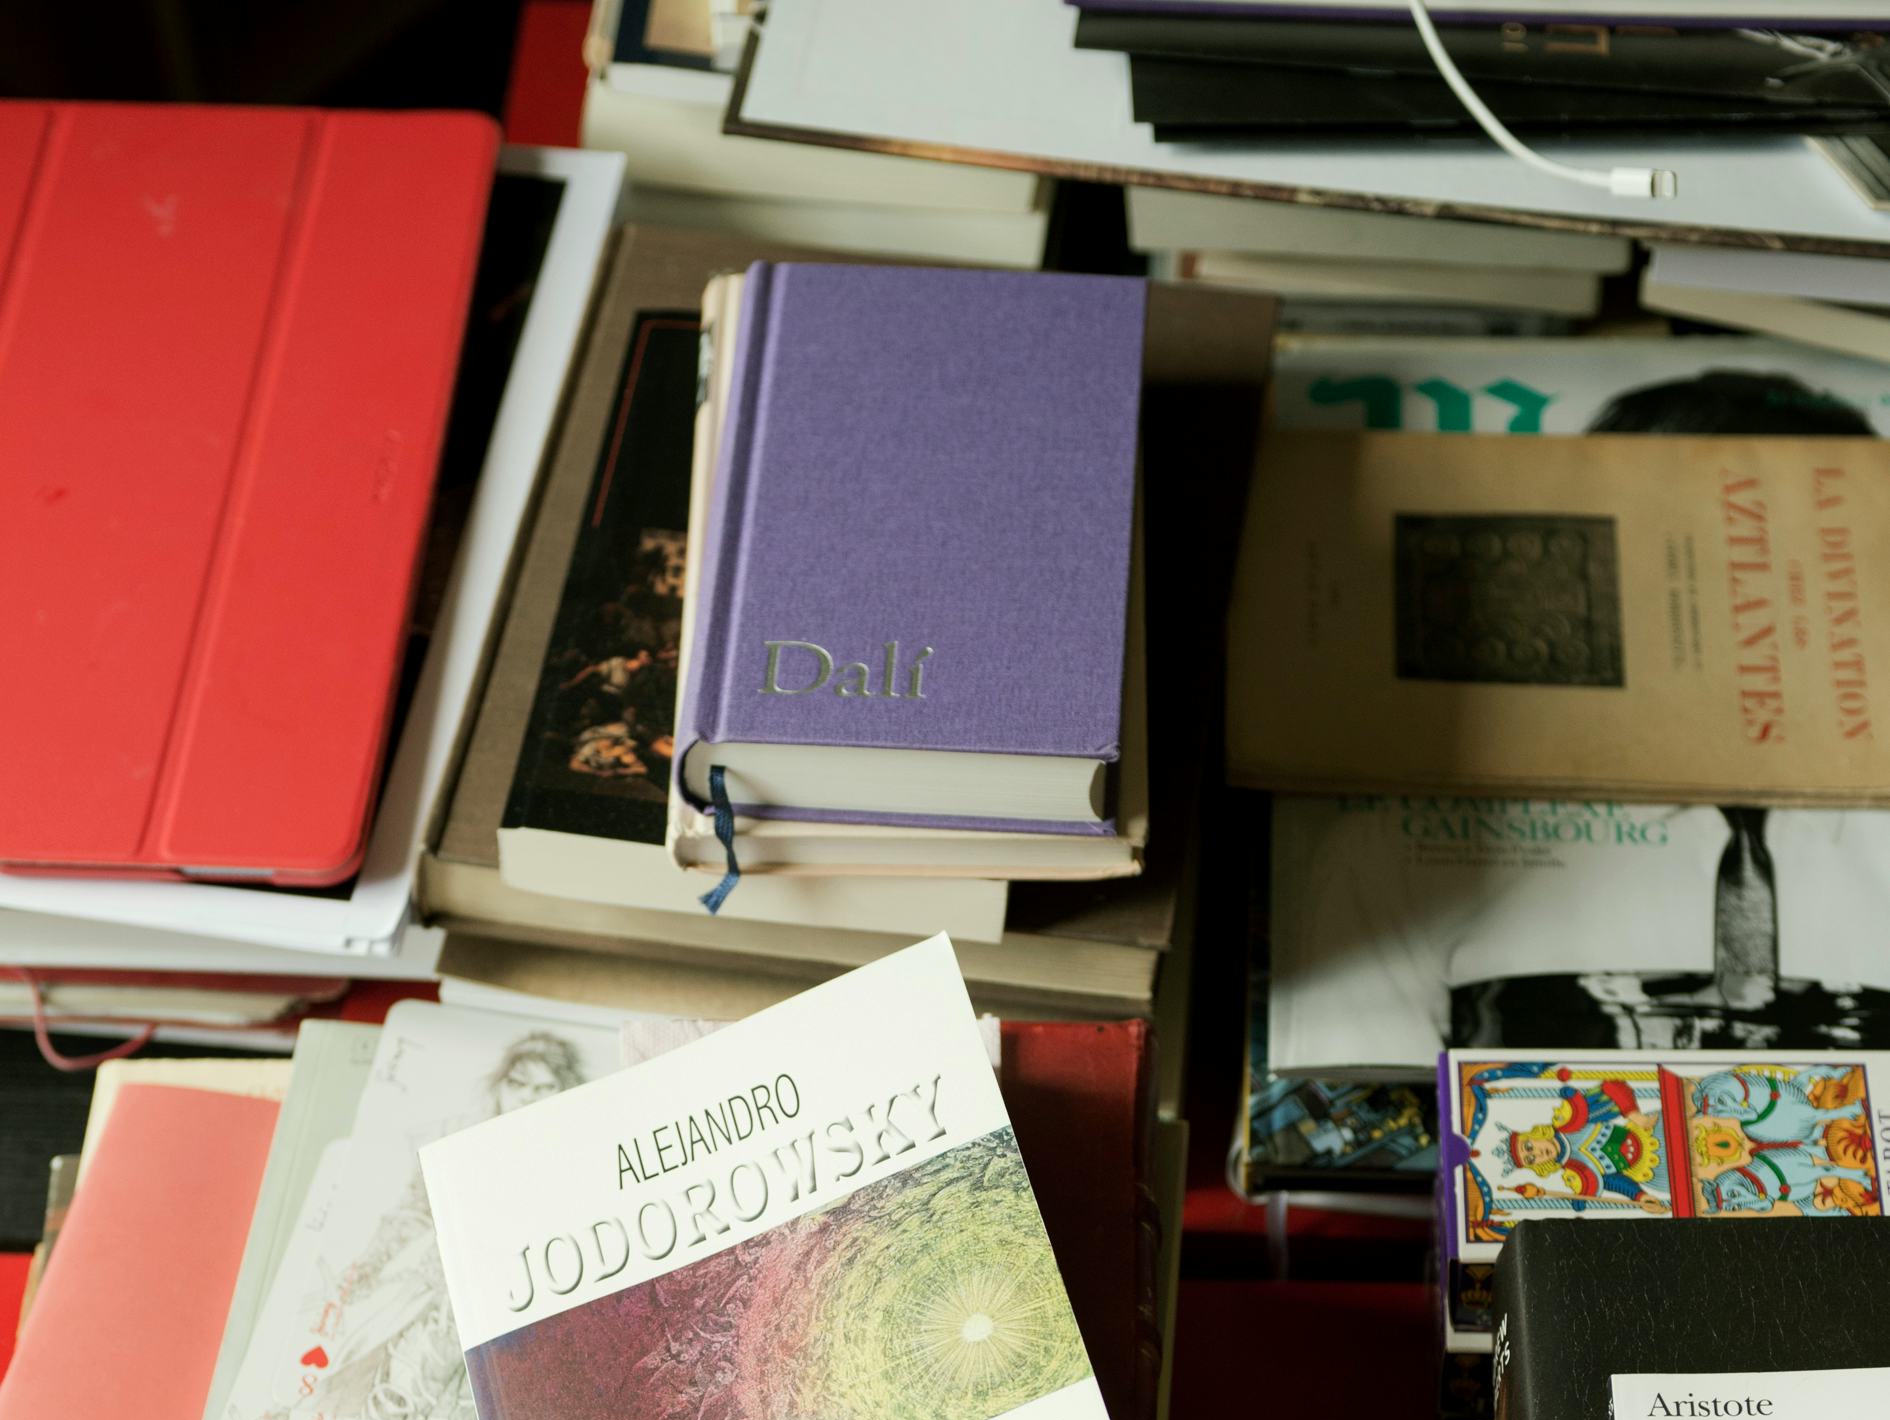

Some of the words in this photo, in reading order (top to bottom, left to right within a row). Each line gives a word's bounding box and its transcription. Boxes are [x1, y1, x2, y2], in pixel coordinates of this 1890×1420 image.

[1812, 466, 1846, 512] LA
[1719, 466, 1785, 744] AZTLANTES
[1818, 526, 1873, 741] DIVINATION
[757, 640, 934, 698] Dalí
[1402, 816, 1669, 846] GAINSBOURG
[617, 1074, 802, 1190] ALEJANDRO
[508, 1074, 948, 1312] JODOROWSKY
[1648, 1393, 1774, 1417] Aristote
